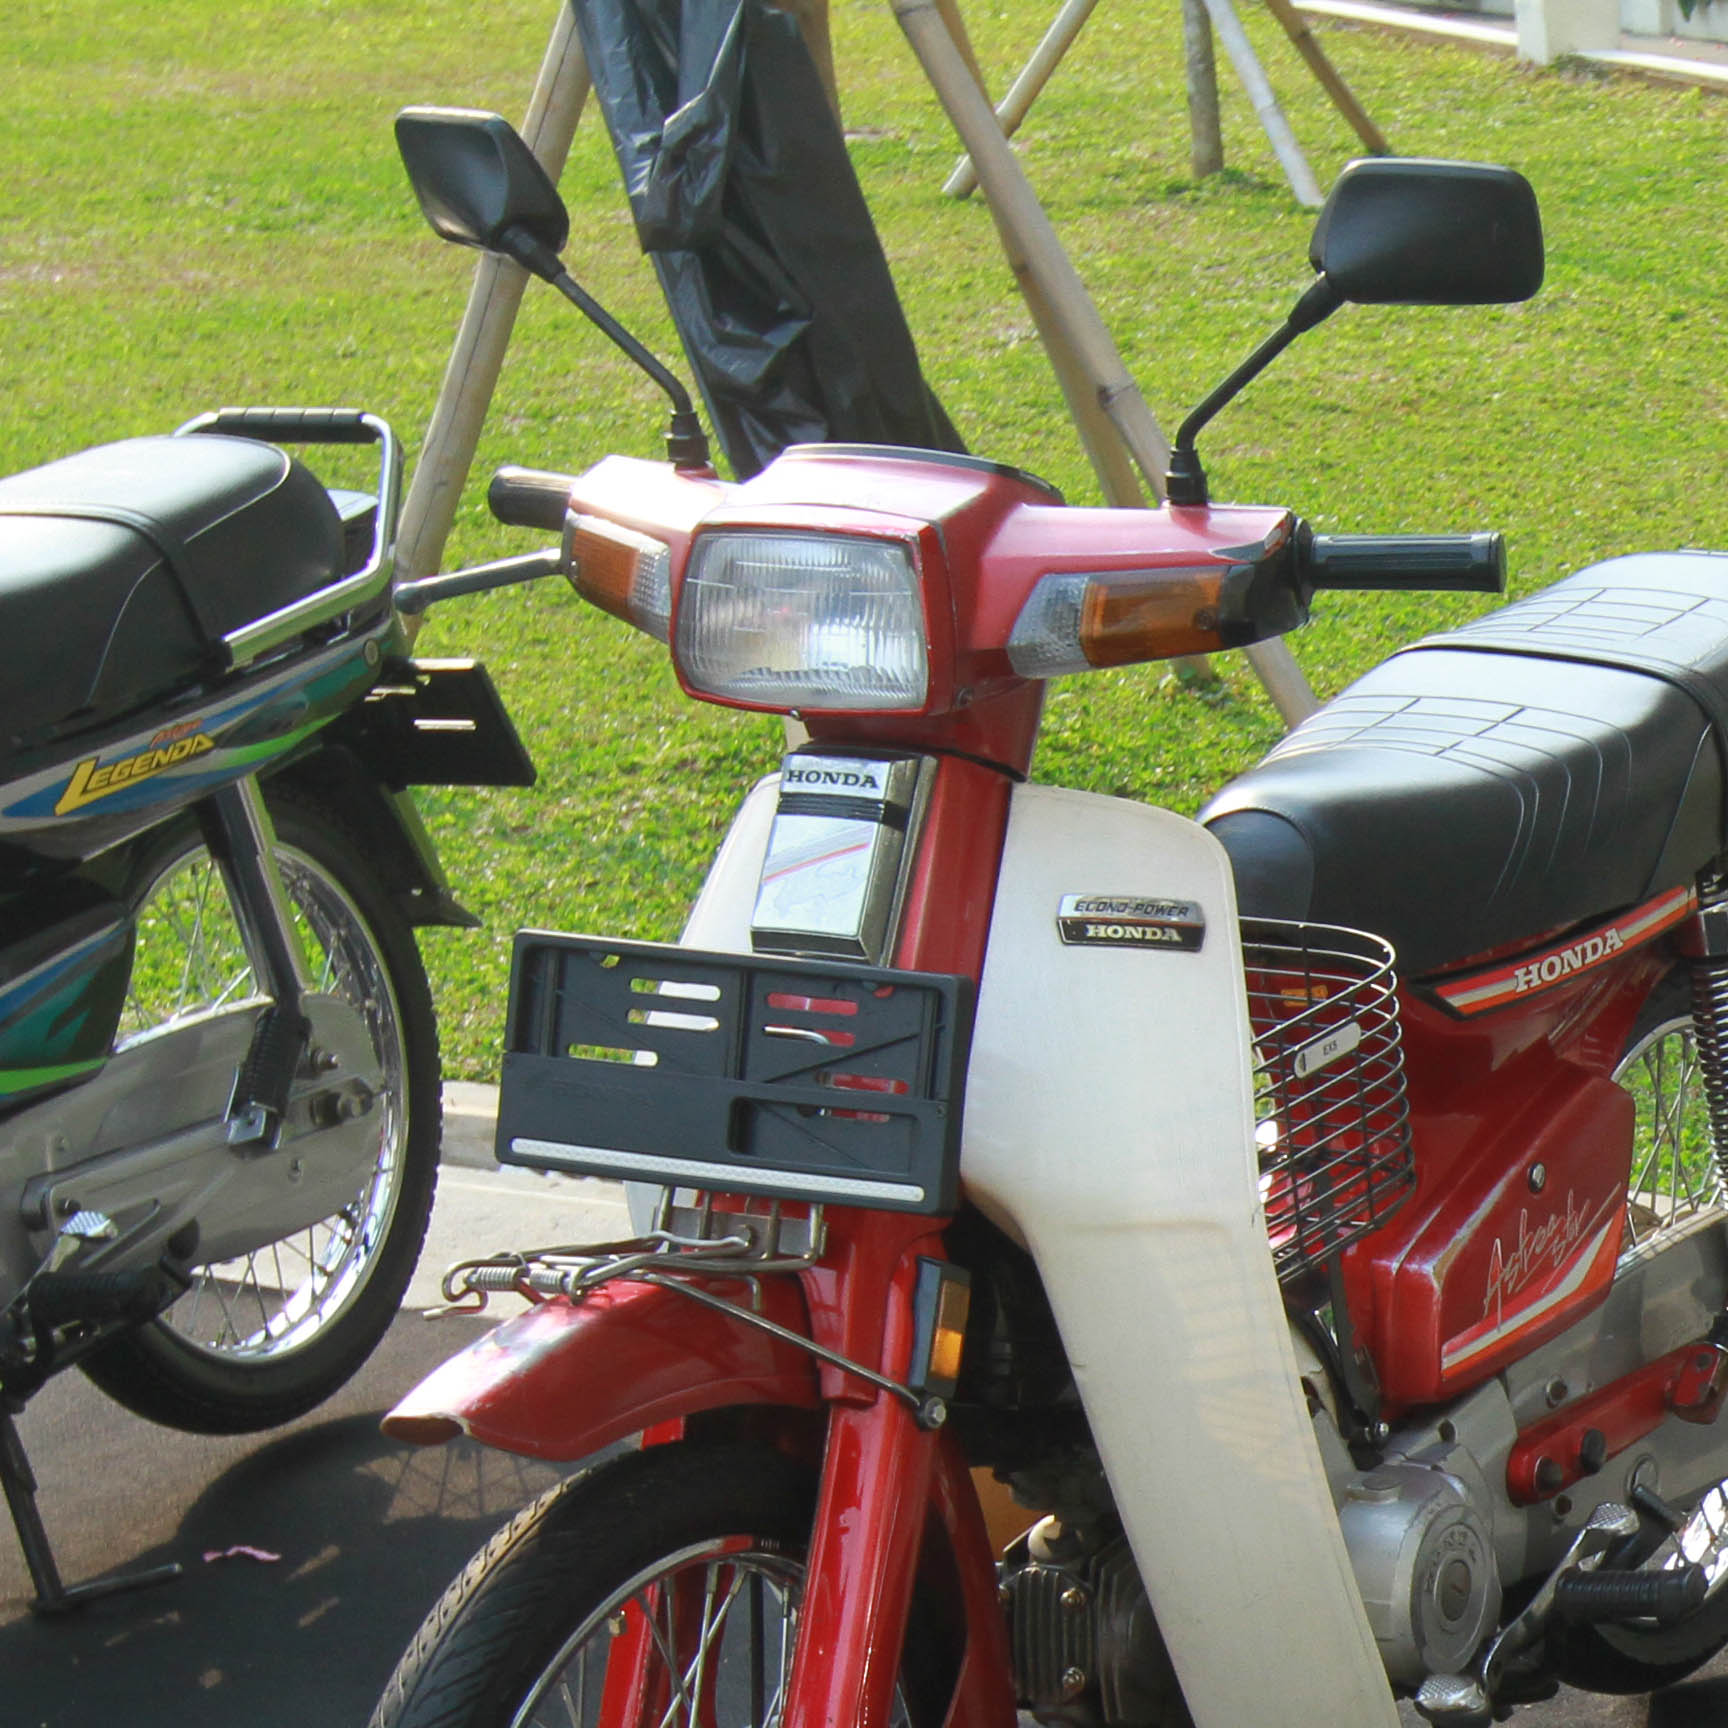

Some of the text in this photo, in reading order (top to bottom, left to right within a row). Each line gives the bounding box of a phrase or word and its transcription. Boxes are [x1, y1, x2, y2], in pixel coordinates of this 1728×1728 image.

[55, 733, 214, 816] LEGENDA
[786, 769, 879, 789] HONDA
[1074, 901, 1189, 917] ECONO-POWER
[1085, 924, 1182, 942] HONDA
[1514, 927, 1623, 993] HONDA
